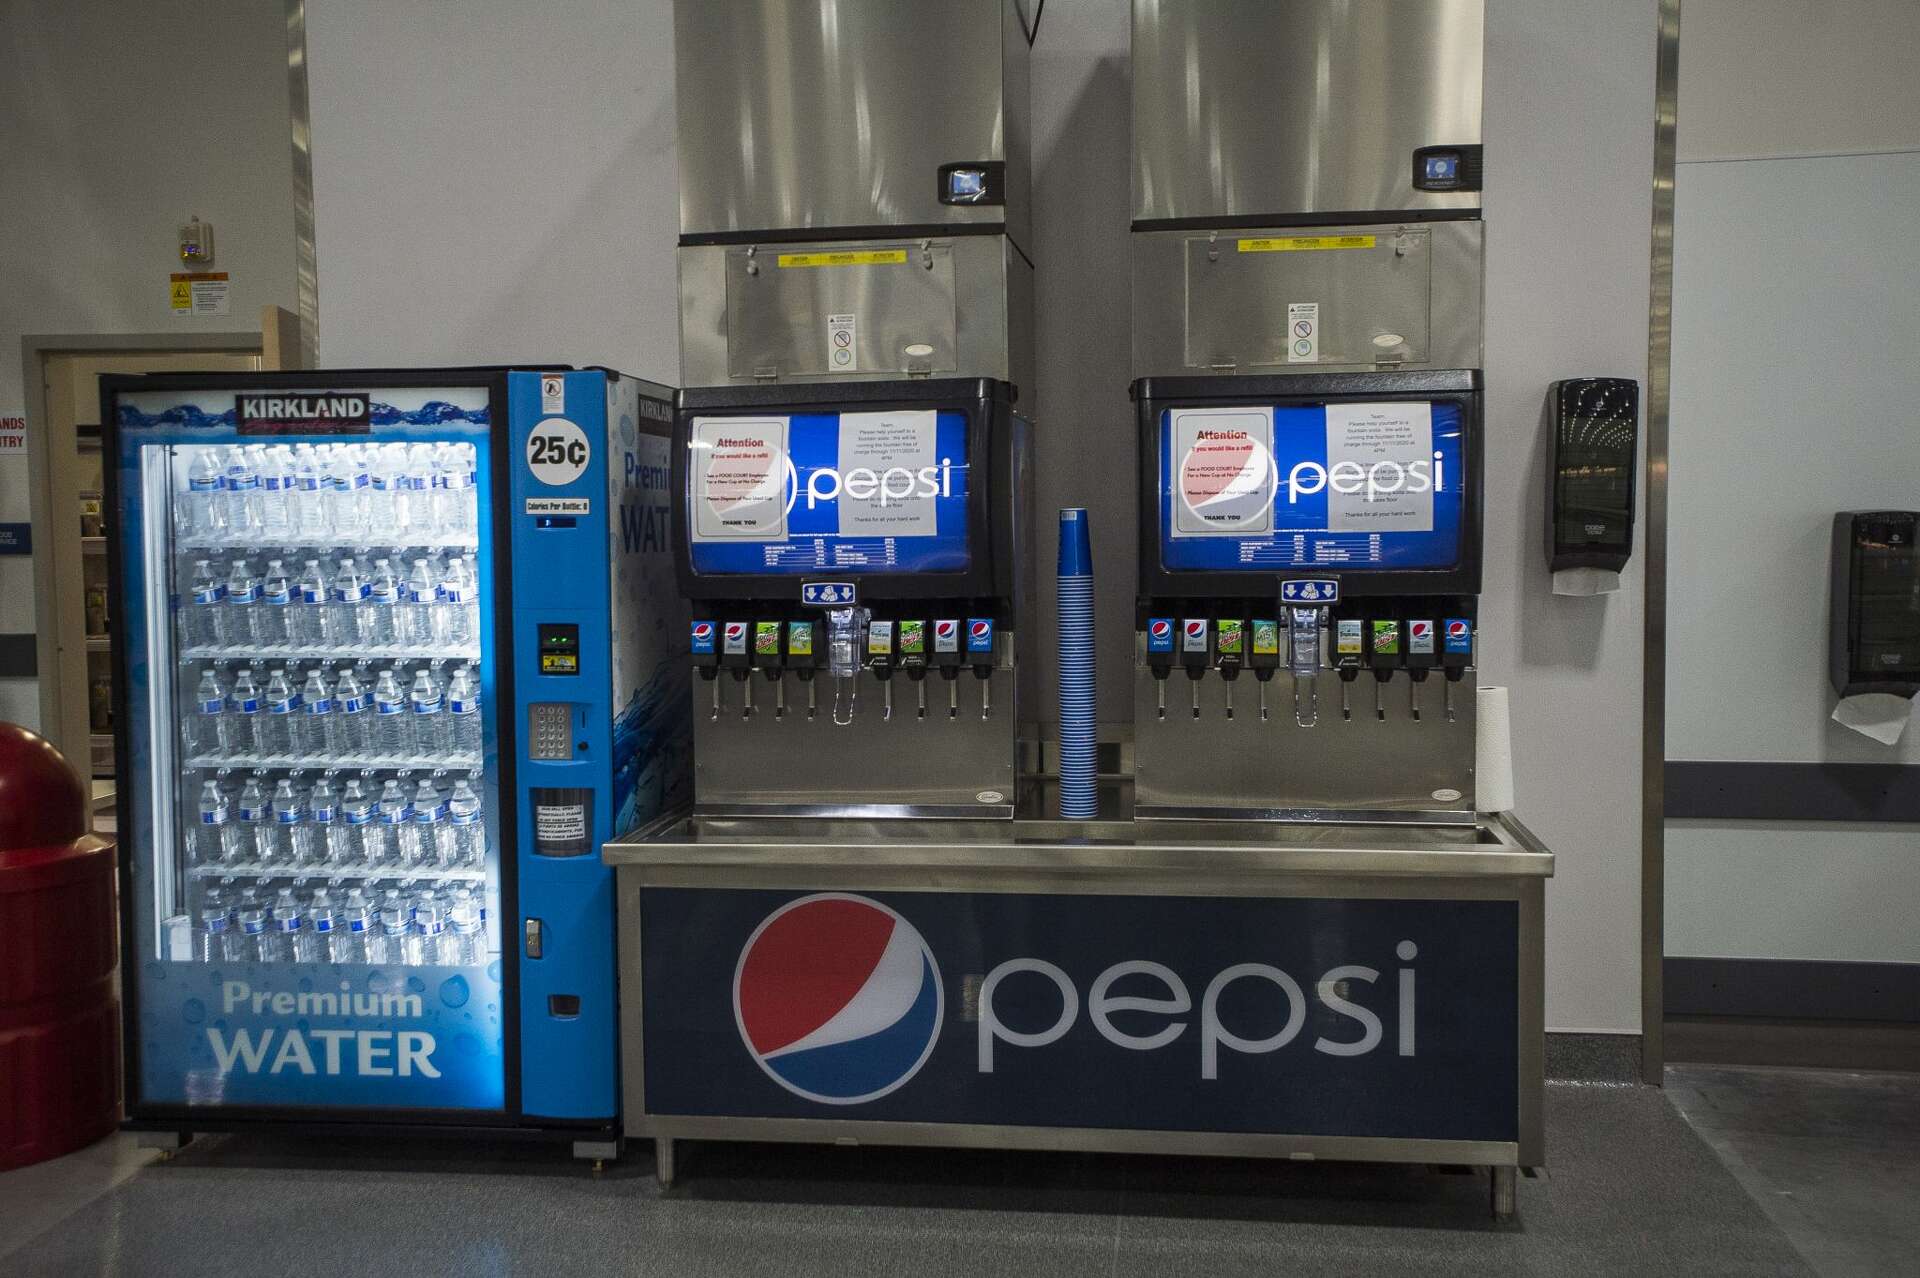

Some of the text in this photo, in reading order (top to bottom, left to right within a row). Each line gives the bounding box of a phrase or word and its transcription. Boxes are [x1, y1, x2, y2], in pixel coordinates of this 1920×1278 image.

[243, 398, 364, 418] KIRKLAND
[640, 399, 672, 423] KIRKLAN
[530, 435, 586, 468] 25¢
[717, 438, 764, 447] Attention
[1196, 430, 1247, 440] Attention
[624, 451, 672, 489] Premi
[808, 458, 951, 510] pepsi
[1288, 450, 1443, 504] pepsi
[528, 502, 548, 510] Calories
[550, 502, 560, 510] Per
[620, 504, 669, 554] WAT
[222, 980, 423, 1017] Premium
[978, 940, 1417, 1080] pepsi
[207, 1027, 442, 1079] WATER
